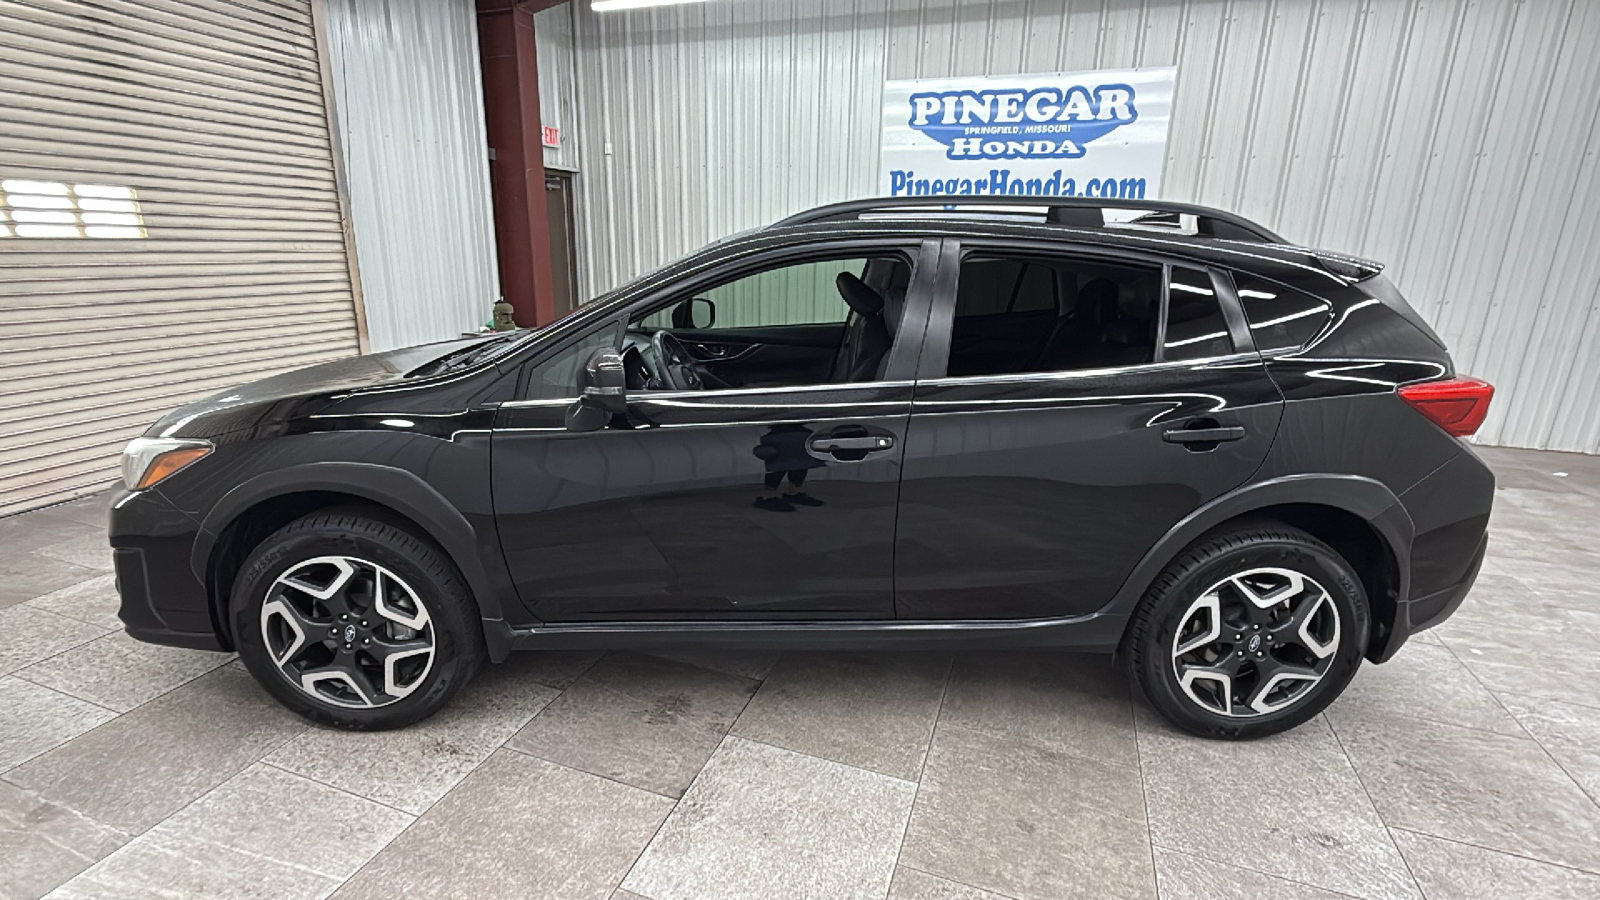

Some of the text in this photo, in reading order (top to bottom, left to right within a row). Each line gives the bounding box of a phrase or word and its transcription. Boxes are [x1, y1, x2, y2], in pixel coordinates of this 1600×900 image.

[913, 89, 1133, 125] PINEGAR
[544, 127, 558, 146] EXIT
[964, 125, 1071, 135] SPRINGFIELD, MISSOURI
[952, 138, 1081, 155] HONDA
[890, 169, 1146, 200] PinegarHonda.com
